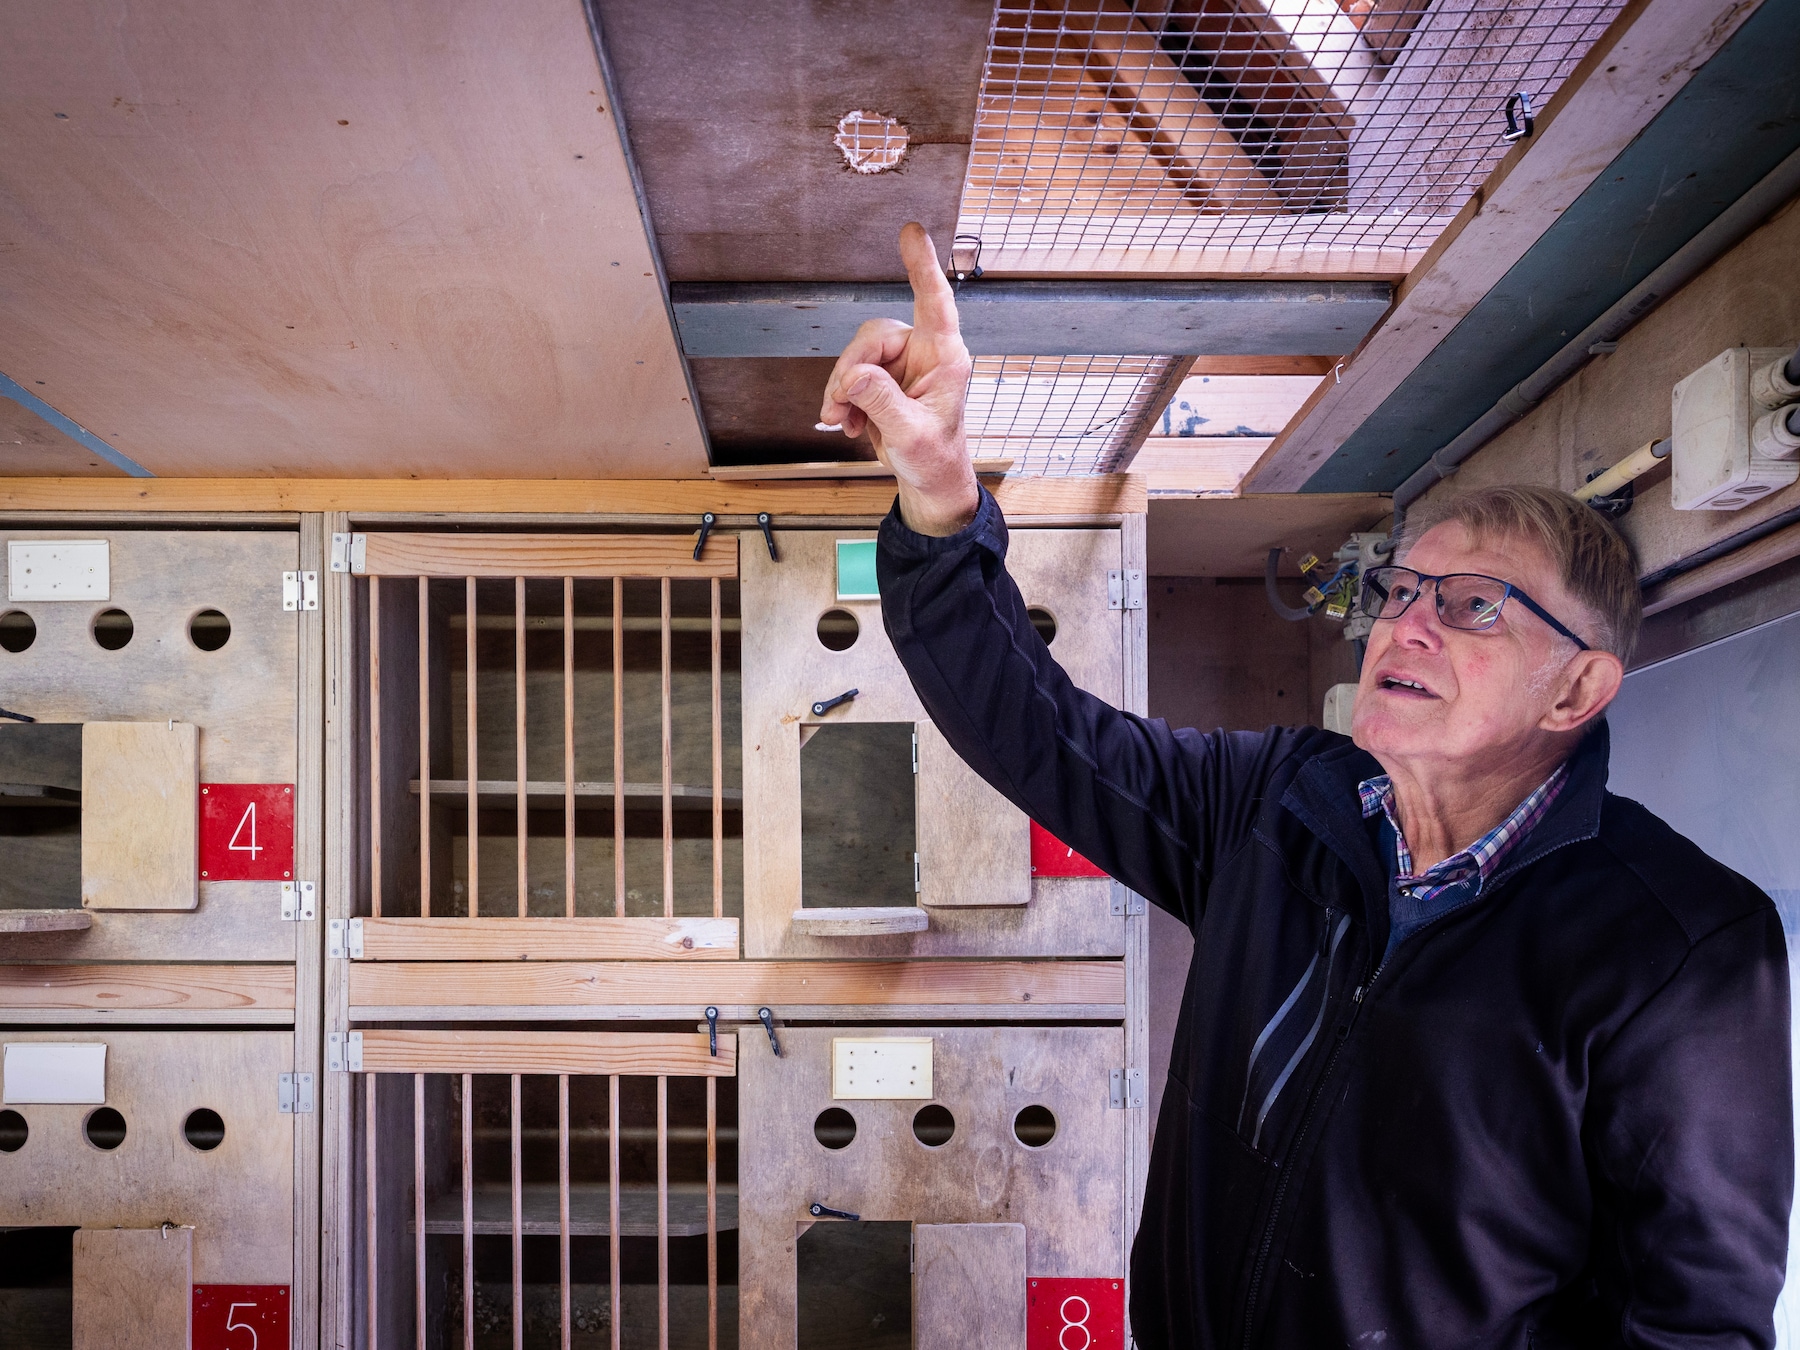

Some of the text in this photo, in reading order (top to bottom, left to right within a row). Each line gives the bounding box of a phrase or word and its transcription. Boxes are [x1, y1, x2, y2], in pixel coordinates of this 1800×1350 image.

[228, 801, 264, 861] 4
[226, 1302, 258, 1350] 5
[1059, 1296, 1091, 1350] 8
